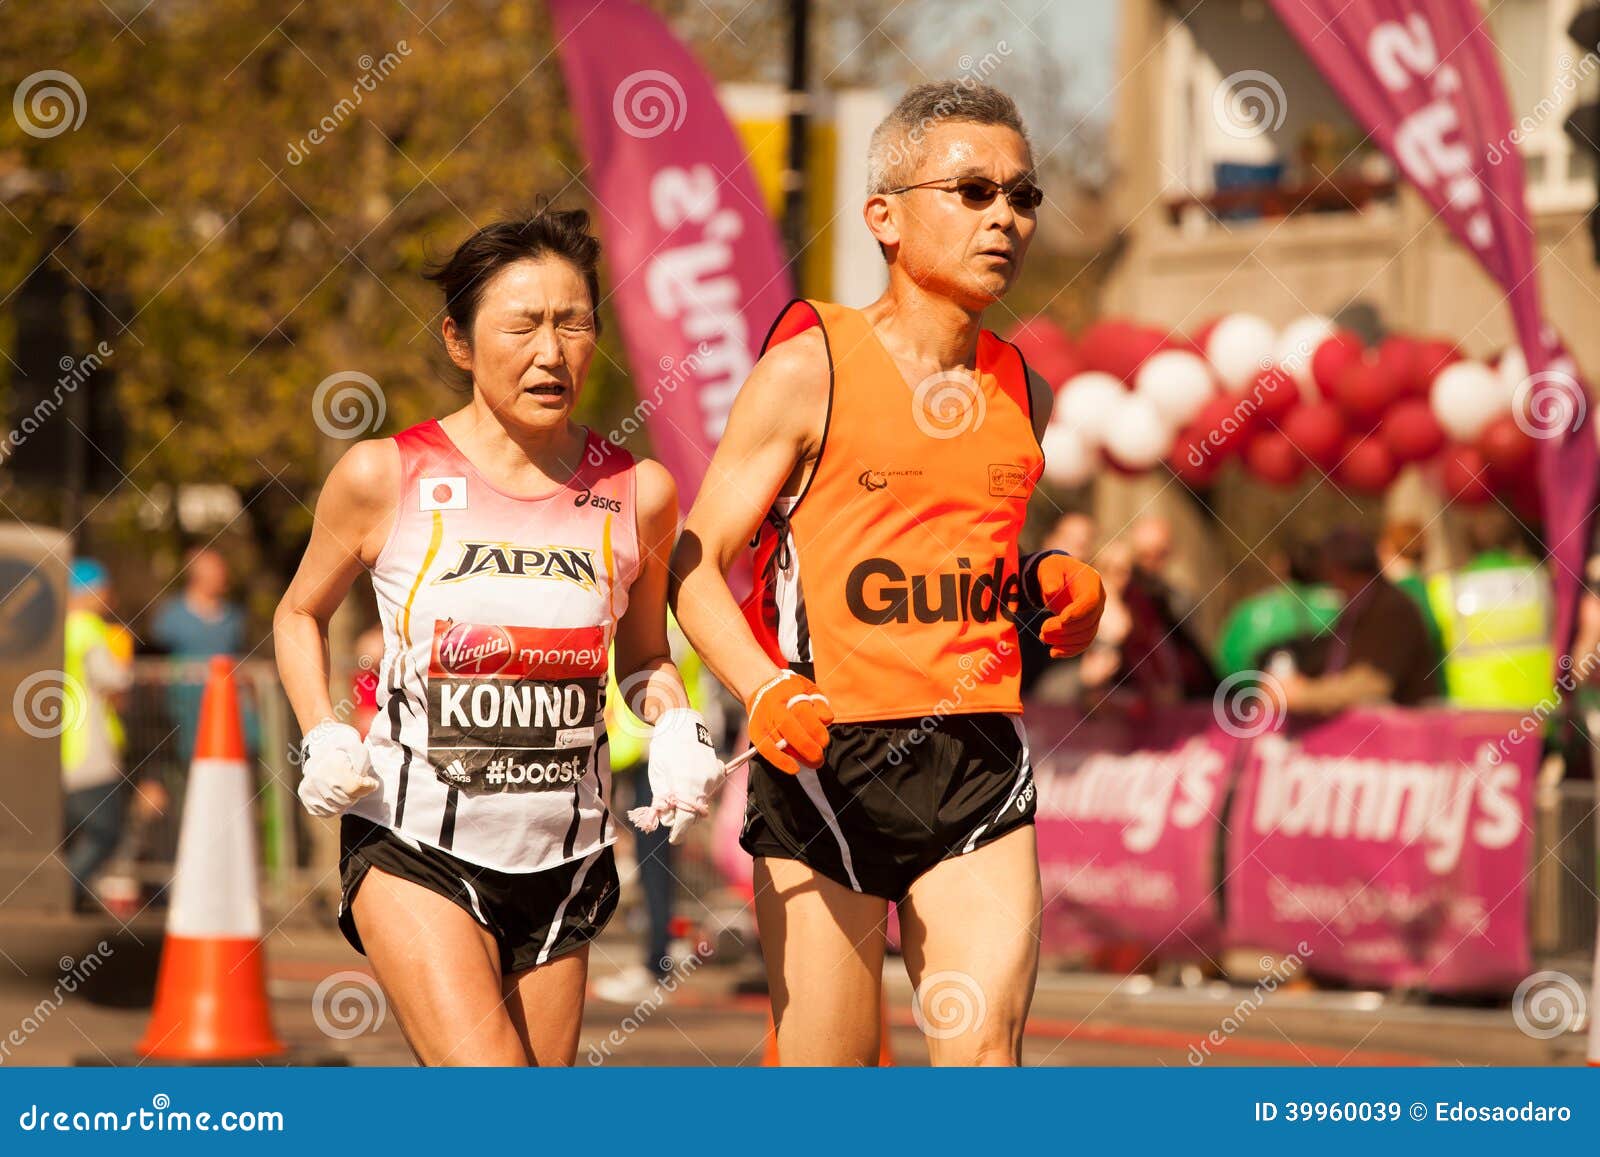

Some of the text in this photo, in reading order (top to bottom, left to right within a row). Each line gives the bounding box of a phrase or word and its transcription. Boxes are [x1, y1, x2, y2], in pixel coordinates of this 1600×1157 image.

[590, 494, 622, 513] asics
[438, 543, 599, 587] JAPAN
[845, 557, 1018, 626] Guide
[443, 623, 603, 673] Virgin money
[440, 683, 586, 728] KONNO
[485, 755, 581, 785] #boost
